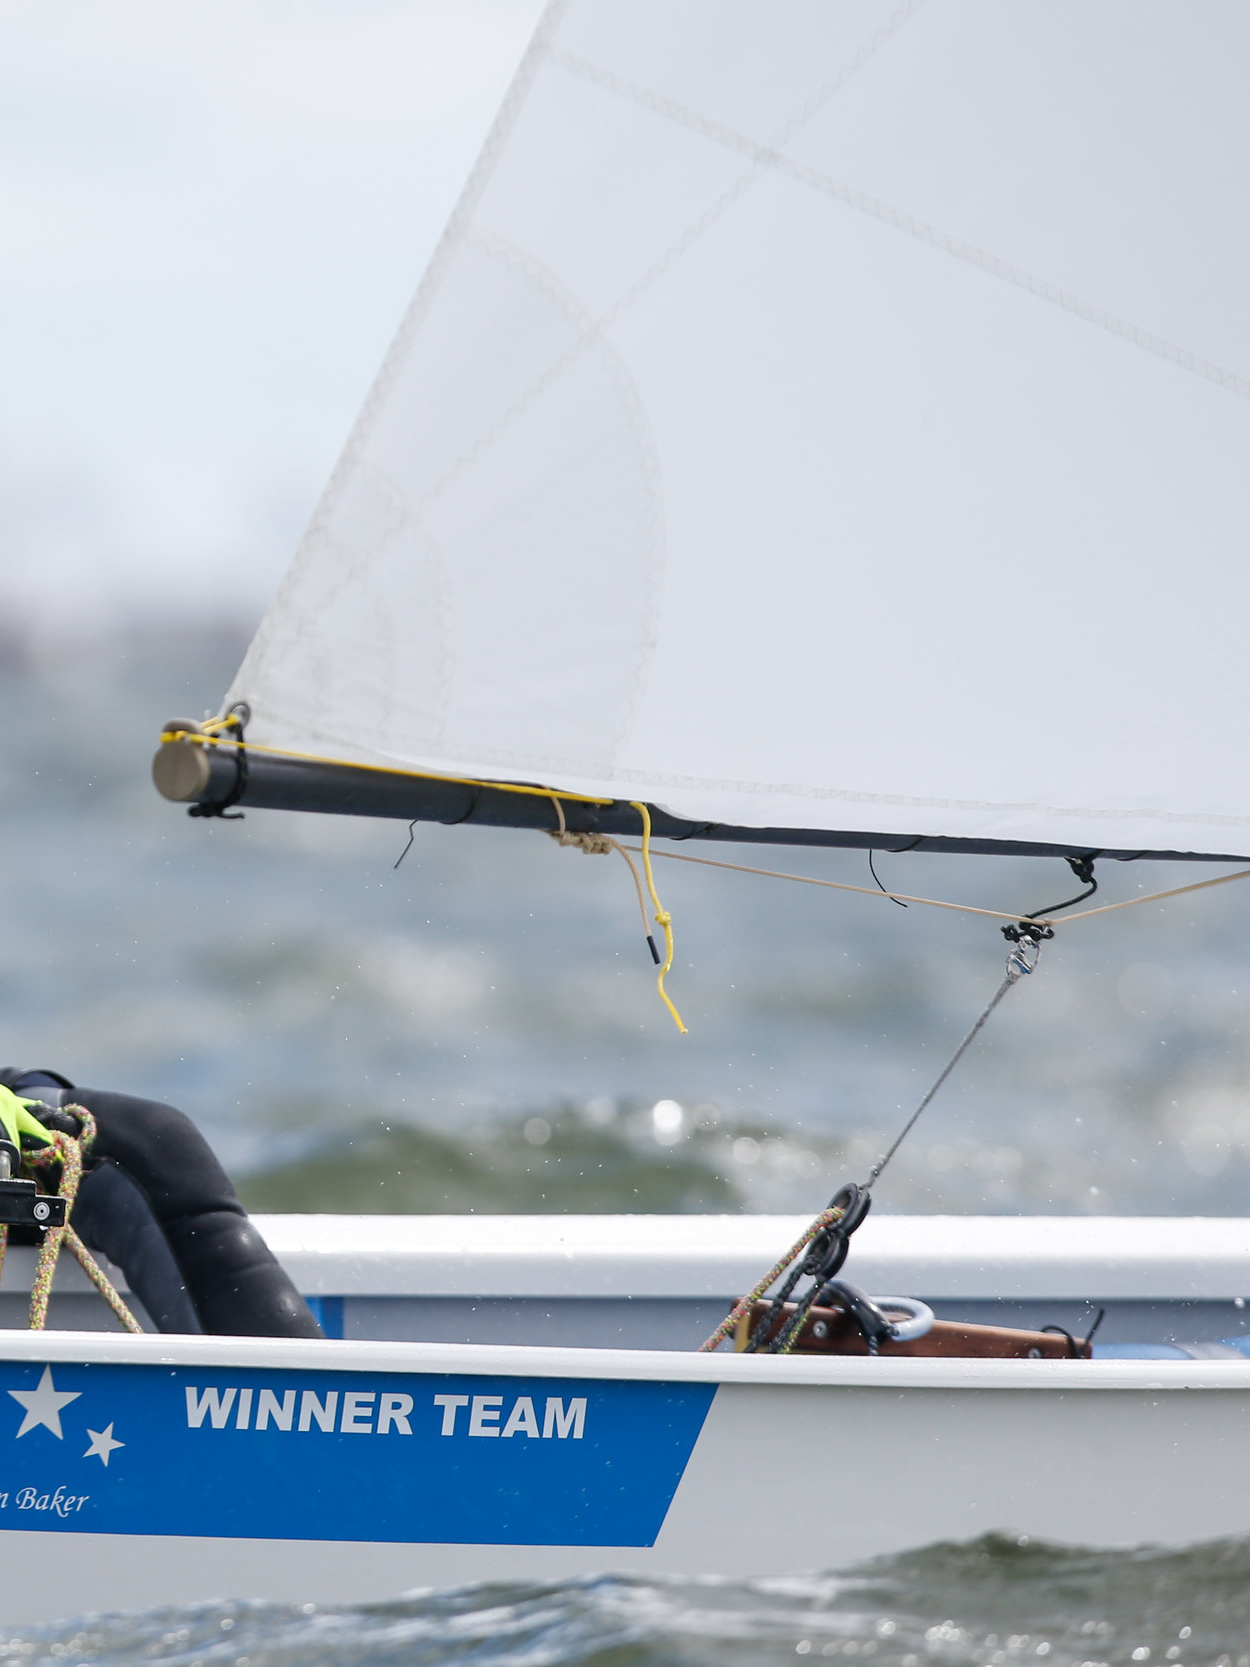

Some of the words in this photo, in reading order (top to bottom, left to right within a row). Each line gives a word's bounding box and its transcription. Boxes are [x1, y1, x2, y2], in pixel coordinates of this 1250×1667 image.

[185, 1385, 414, 1435] WINNER
[433, 1394, 588, 1439] TEAM
[15, 1485, 90, 1518] Baker
